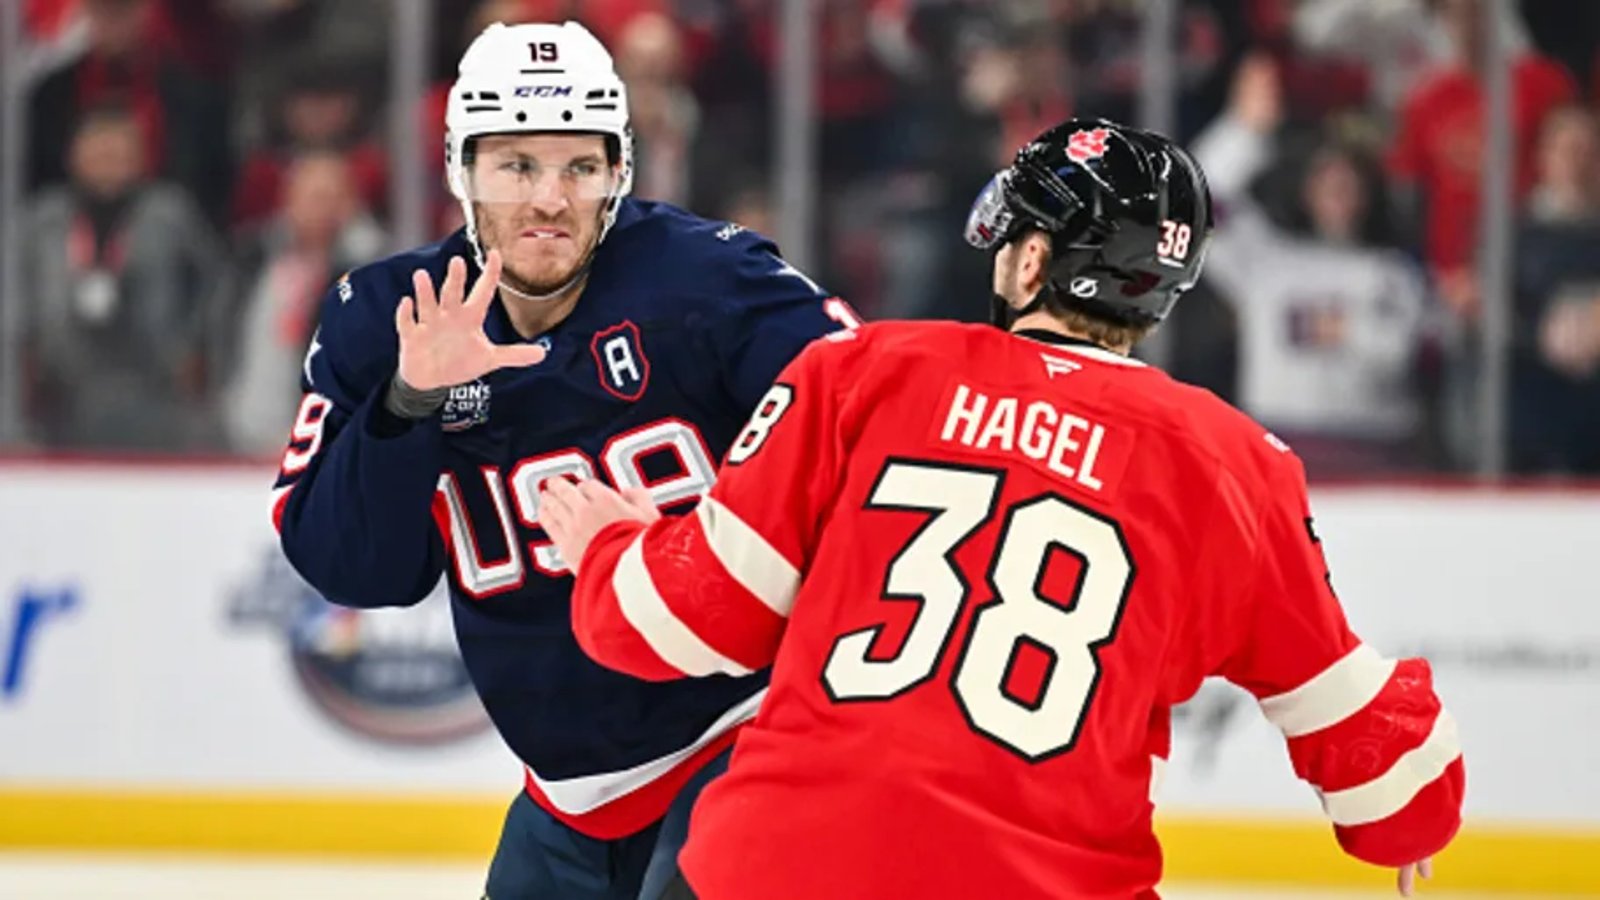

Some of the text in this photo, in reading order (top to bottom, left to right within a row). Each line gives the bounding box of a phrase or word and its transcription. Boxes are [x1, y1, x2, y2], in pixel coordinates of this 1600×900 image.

[528, 42, 559, 63] 19
[513, 86, 573, 98] CCM
[1156, 220, 1191, 259] 38
[604, 336, 640, 387] A
[449, 384, 491, 400] IONS
[941, 384, 1105, 491] HAGEL
[820, 455, 1139, 766] 38
